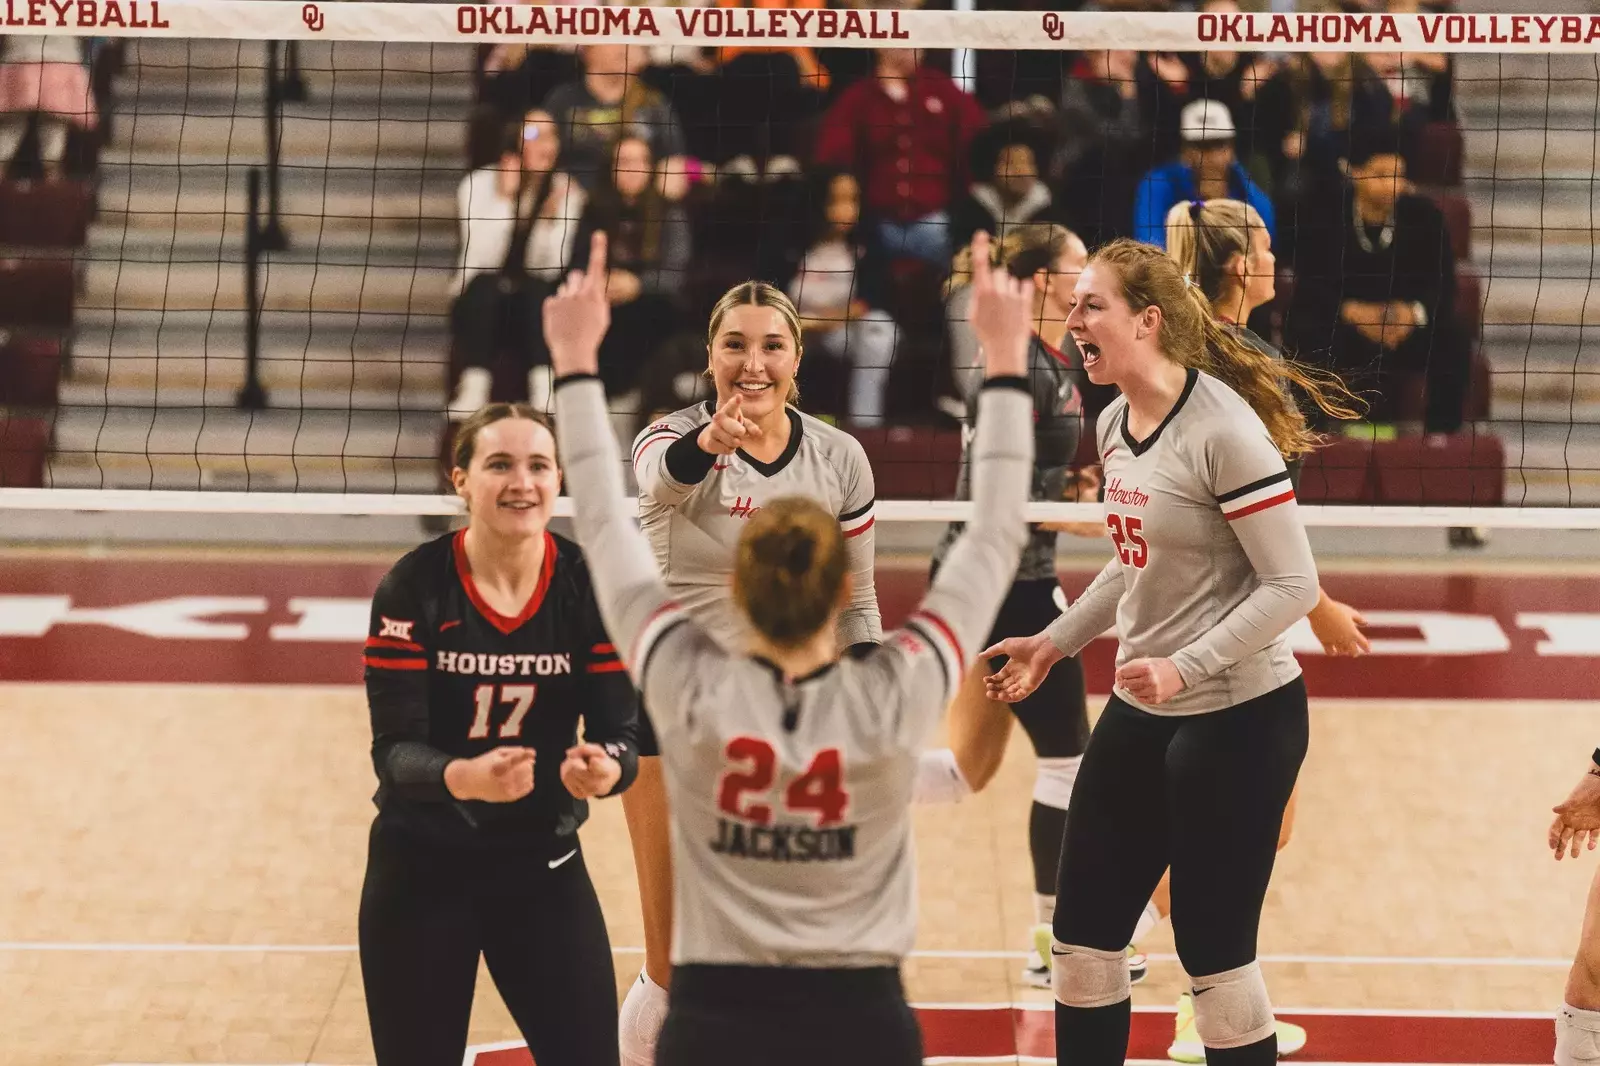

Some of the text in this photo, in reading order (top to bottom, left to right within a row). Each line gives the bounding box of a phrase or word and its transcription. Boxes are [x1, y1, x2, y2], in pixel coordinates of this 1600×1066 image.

[0, 0, 169, 28] LEYBALL
[302, 4, 324, 31] OU
[457, 6, 909, 39] OKLAHOMA VOLLEYBALL
[1043, 13, 1064, 40] OU
[1197, 14, 1401, 43] OKLAHOMA
[1106, 477, 1150, 507] Houston
[1105, 512, 1150, 570] 25
[436, 651, 571, 676] HOUSTON
[467, 683, 538, 739] 17
[717, 736, 850, 828] 24
[710, 818, 858, 861] JACKSON
